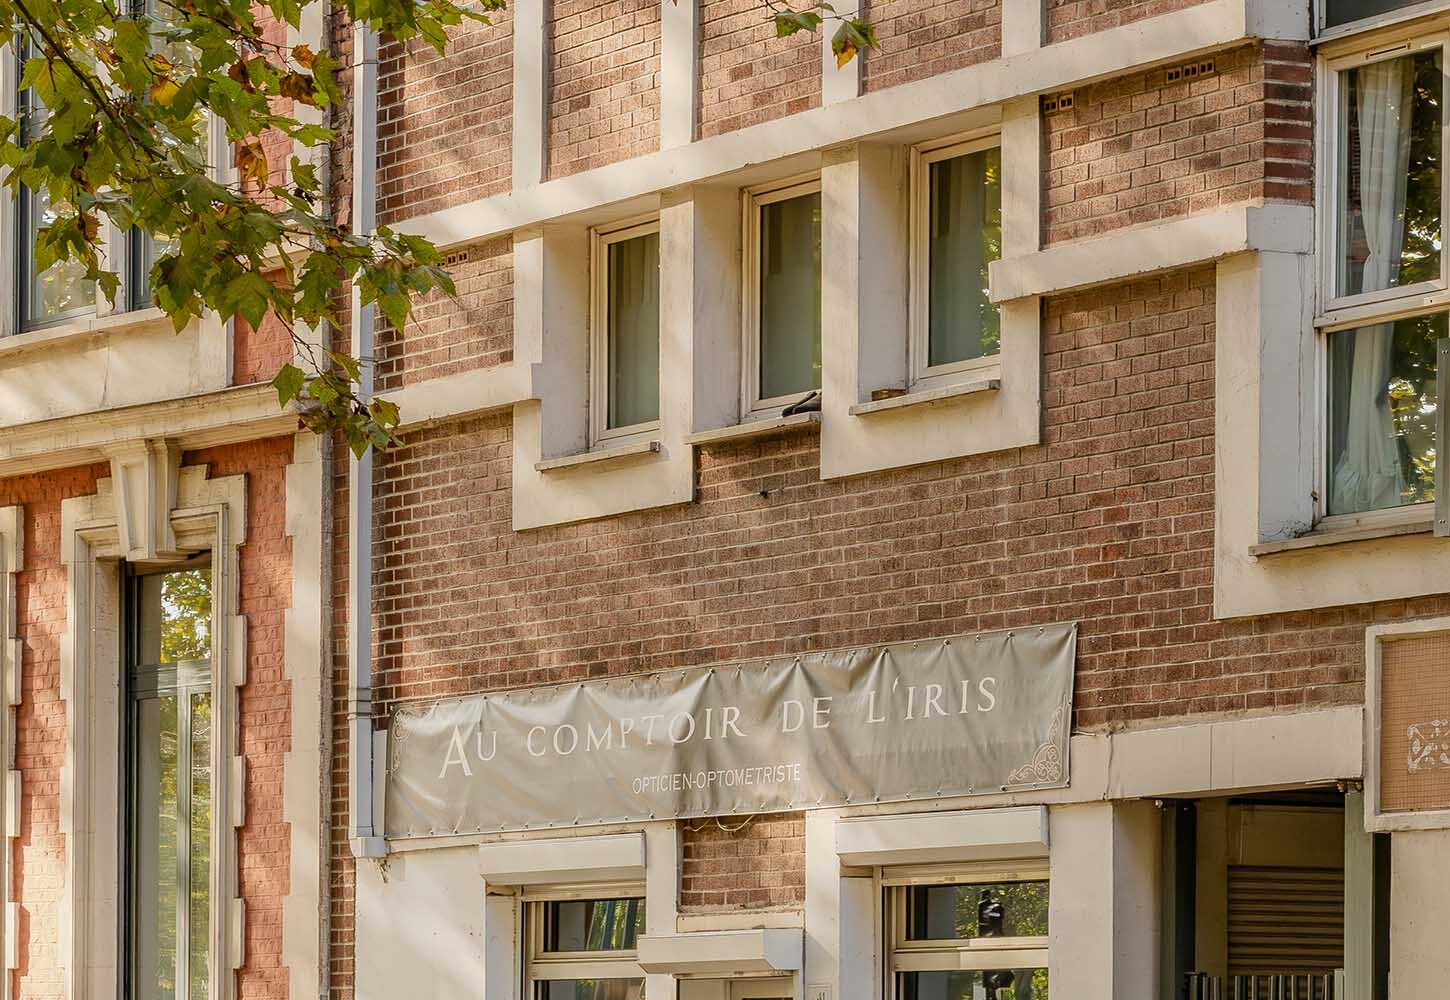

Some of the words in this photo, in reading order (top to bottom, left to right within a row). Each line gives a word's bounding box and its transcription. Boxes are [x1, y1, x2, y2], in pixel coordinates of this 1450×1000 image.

[526, 706, 748, 758] COMPTOIR
[781, 696, 833, 733] DE
[866, 676, 999, 724] L'IRIS
[631, 763, 802, 795] OPTICIEN-OPTOMETRISTE
